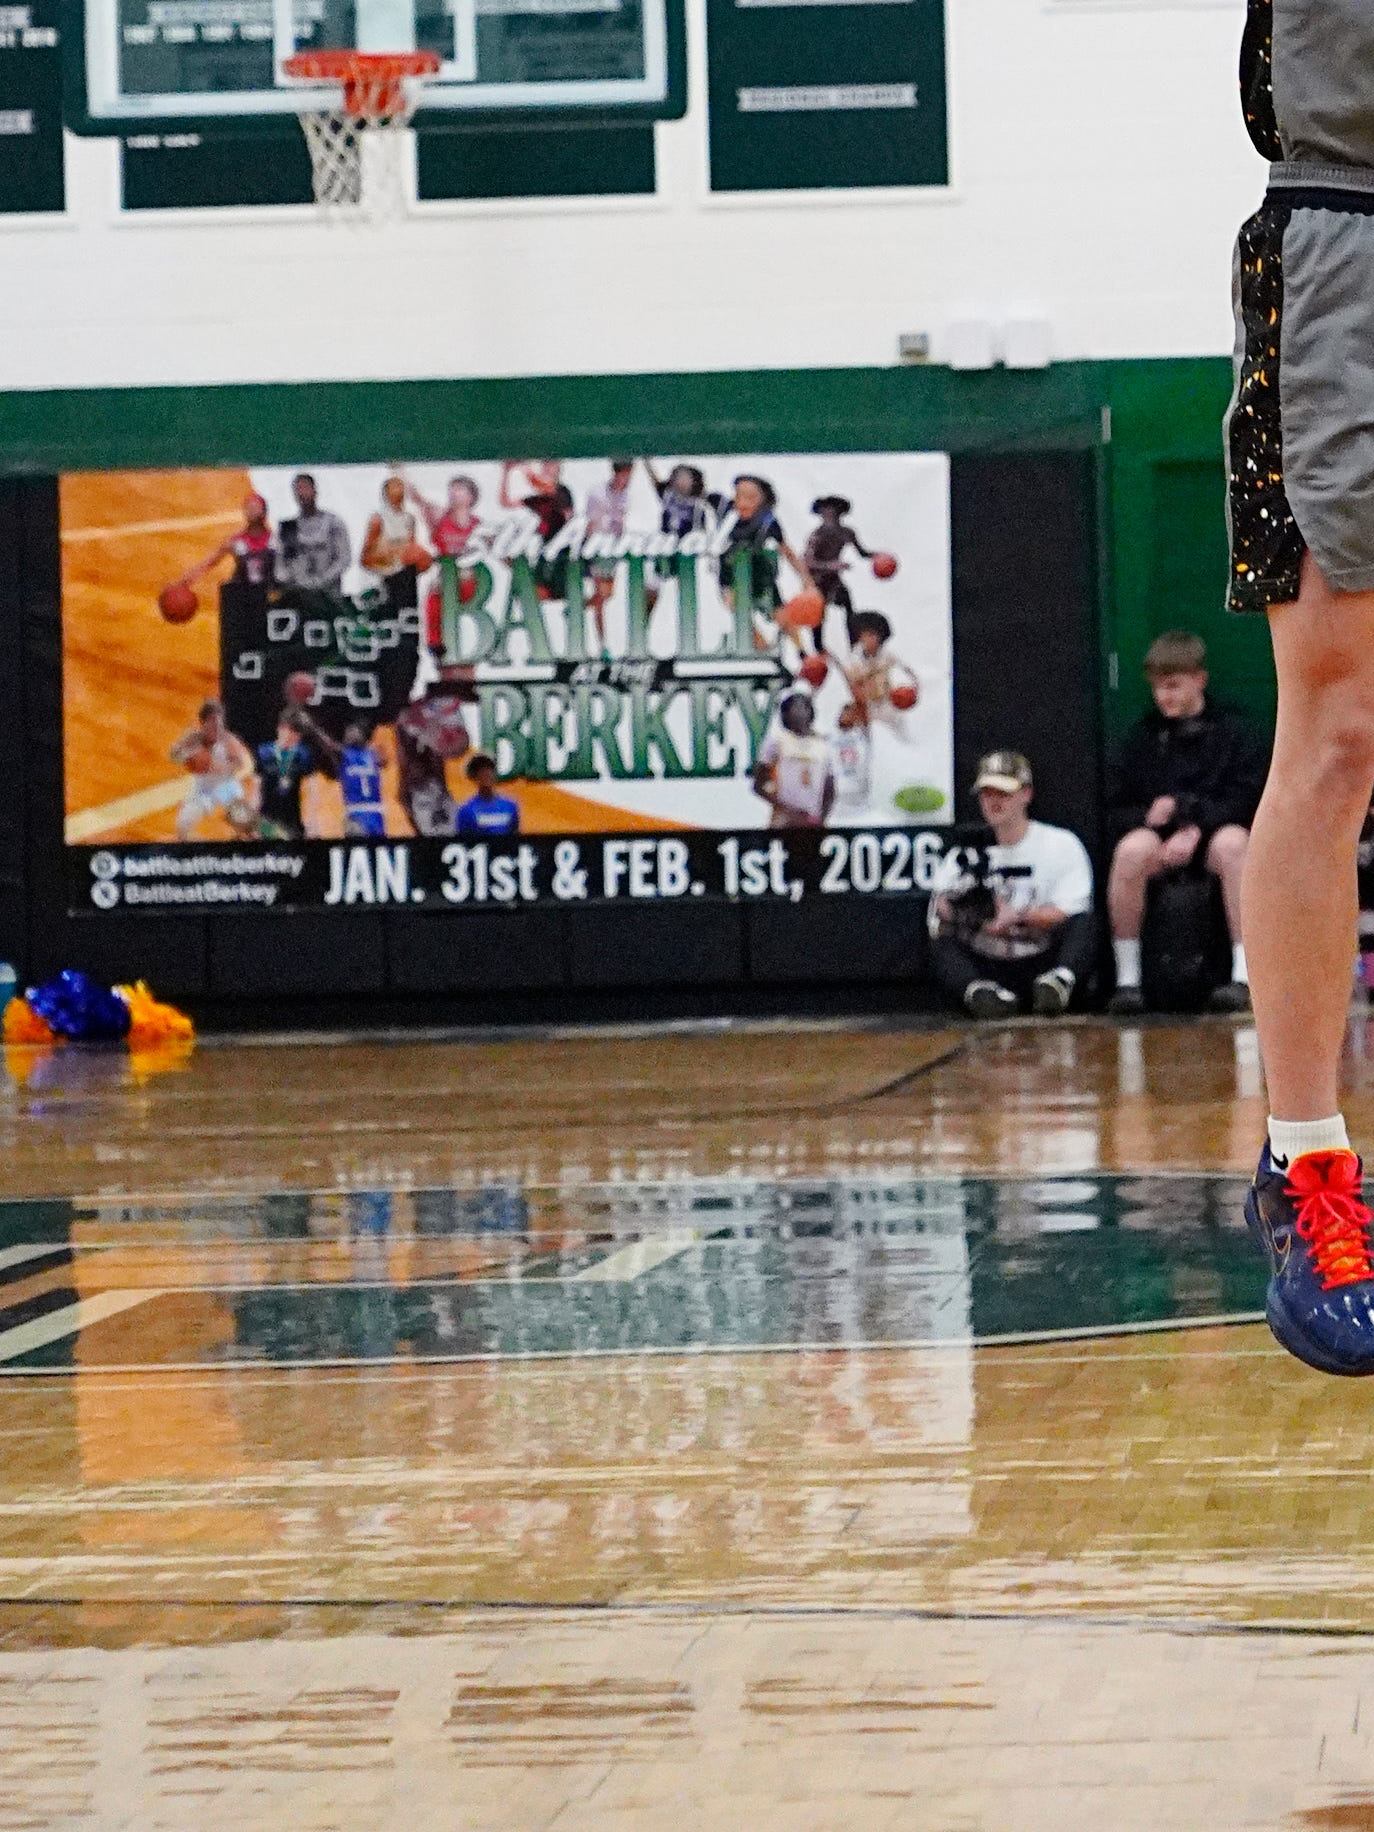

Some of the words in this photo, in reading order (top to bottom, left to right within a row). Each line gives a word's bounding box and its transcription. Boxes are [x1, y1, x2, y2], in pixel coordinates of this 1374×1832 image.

[544, 508, 739, 562] Annual
[474, 679, 784, 781] BERKEY
[324, 844, 427, 905] JAN.
[440, 843, 539, 902] 31st
[552, 840, 588, 901] &
[602, 839, 705, 899] FEB.
[717, 836, 804, 903] 1st,
[819, 832, 946, 895] 2026
